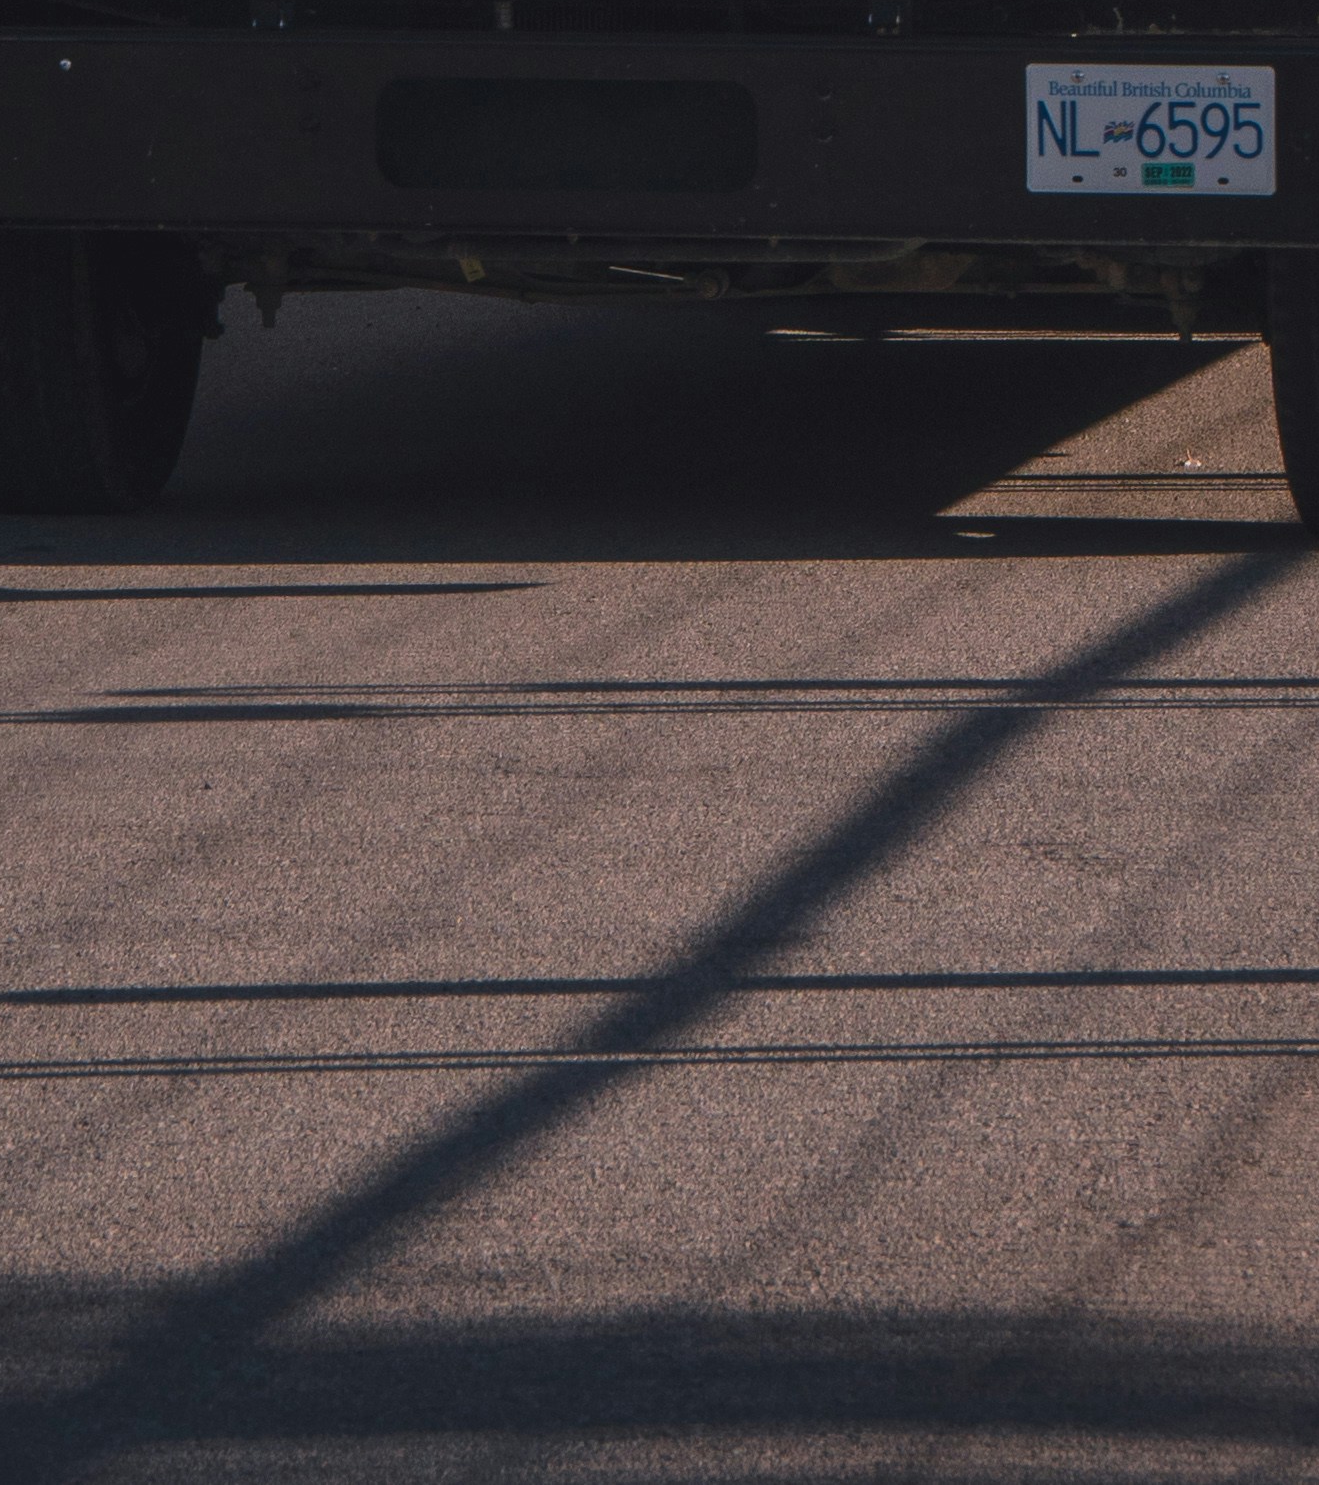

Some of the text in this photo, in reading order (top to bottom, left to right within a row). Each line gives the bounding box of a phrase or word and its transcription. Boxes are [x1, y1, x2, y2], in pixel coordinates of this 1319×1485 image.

[1048, 80, 1252, 99] Beautiful British Columbia
[1036, 99, 1264, 160] NL 6595
[1112, 167, 1128, 179] 30
[1144, 165, 1164, 179] SEP
